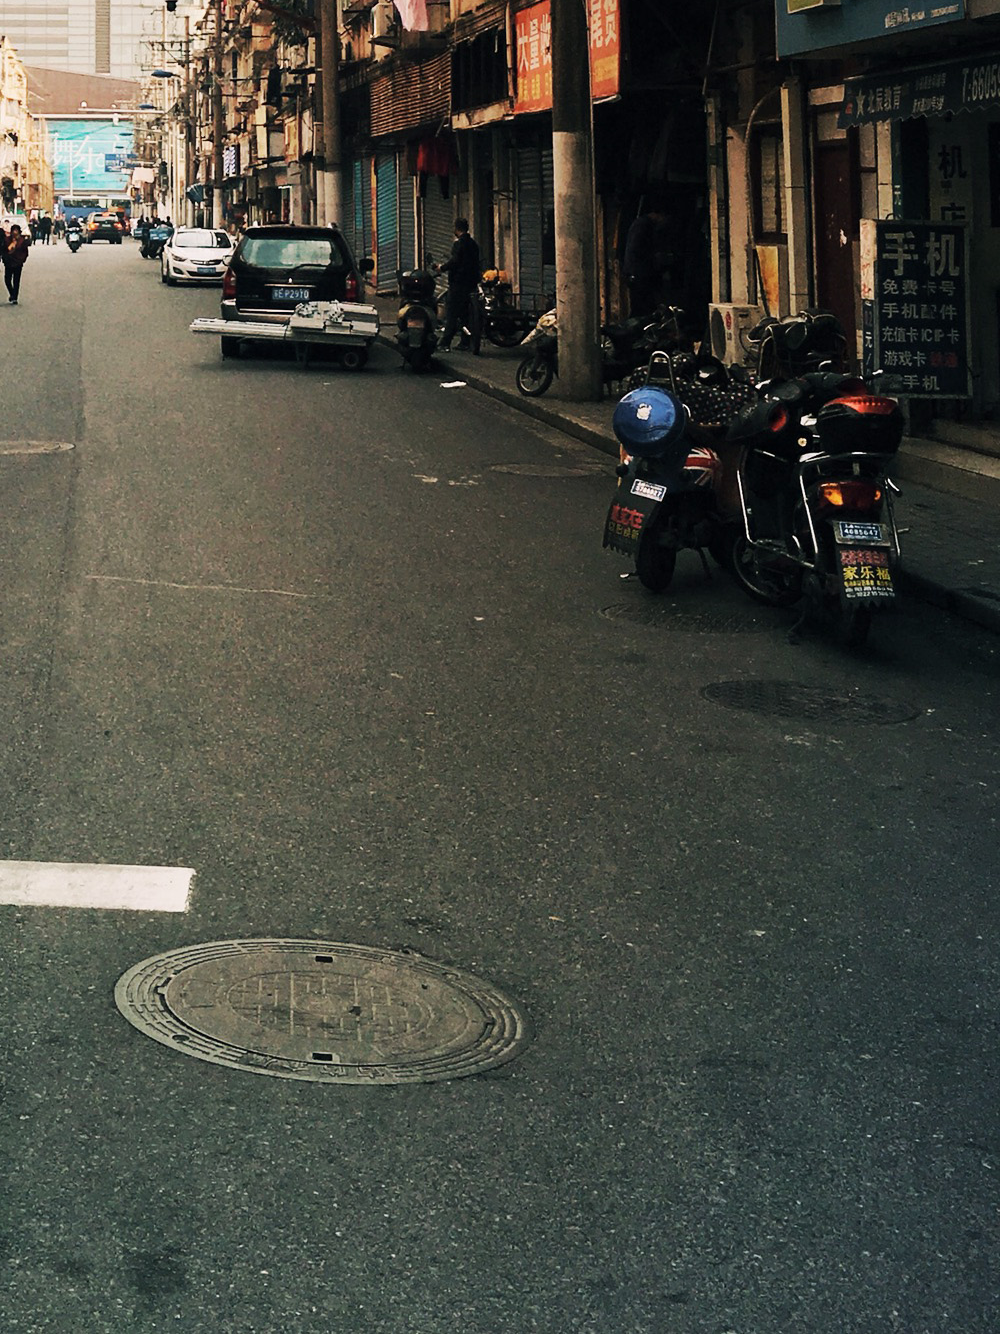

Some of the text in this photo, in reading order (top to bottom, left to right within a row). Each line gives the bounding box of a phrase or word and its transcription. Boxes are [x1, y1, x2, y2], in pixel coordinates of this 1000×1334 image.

[882, 231, 960, 277] 手机
[882, 278, 956, 297] 免费卡号
[882, 302, 958, 321] 手机配件
[884, 350, 927, 367] 游戏卡
[843, 565, 891, 581] 家乐福
